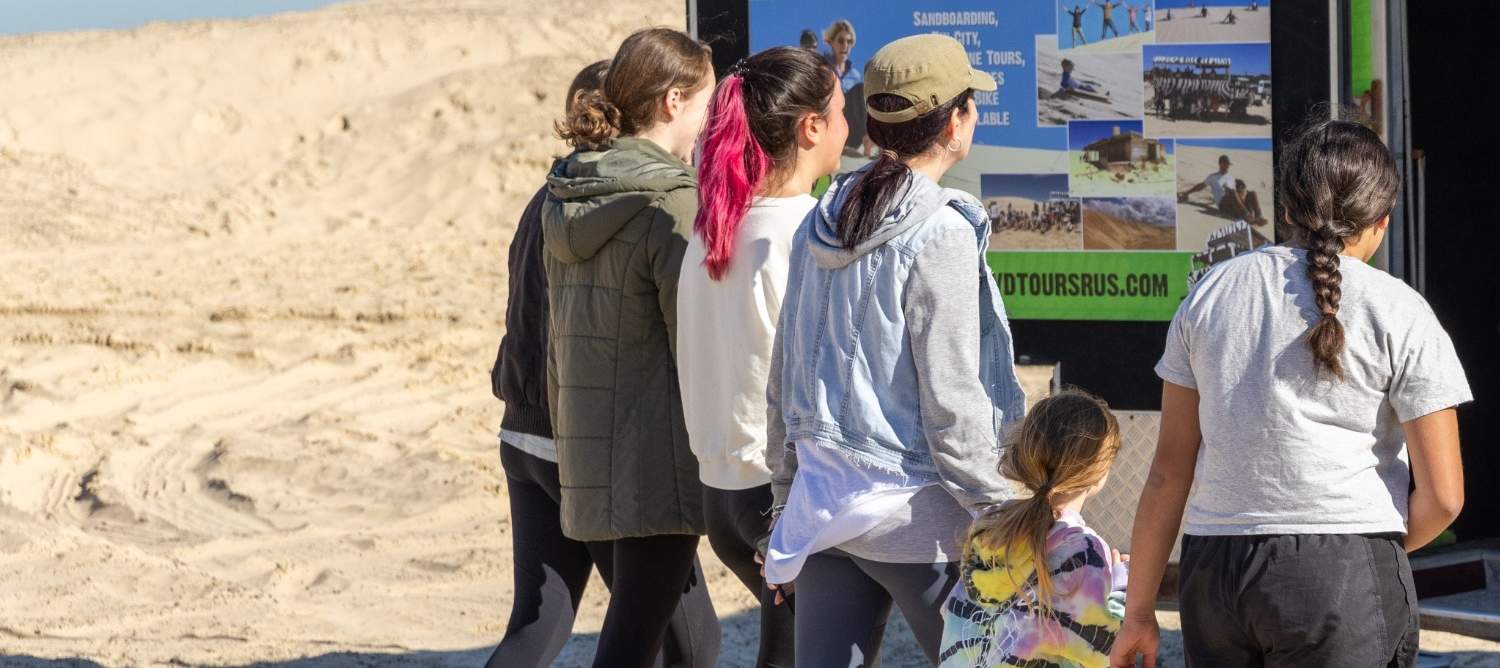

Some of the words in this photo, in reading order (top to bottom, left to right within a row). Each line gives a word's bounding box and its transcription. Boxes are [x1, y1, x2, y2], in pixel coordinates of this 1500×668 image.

[913, 11, 998, 27] SANDBOARDING,
[986, 50, 1025, 67] TOURS,
[977, 111, 1010, 126] LABLE
